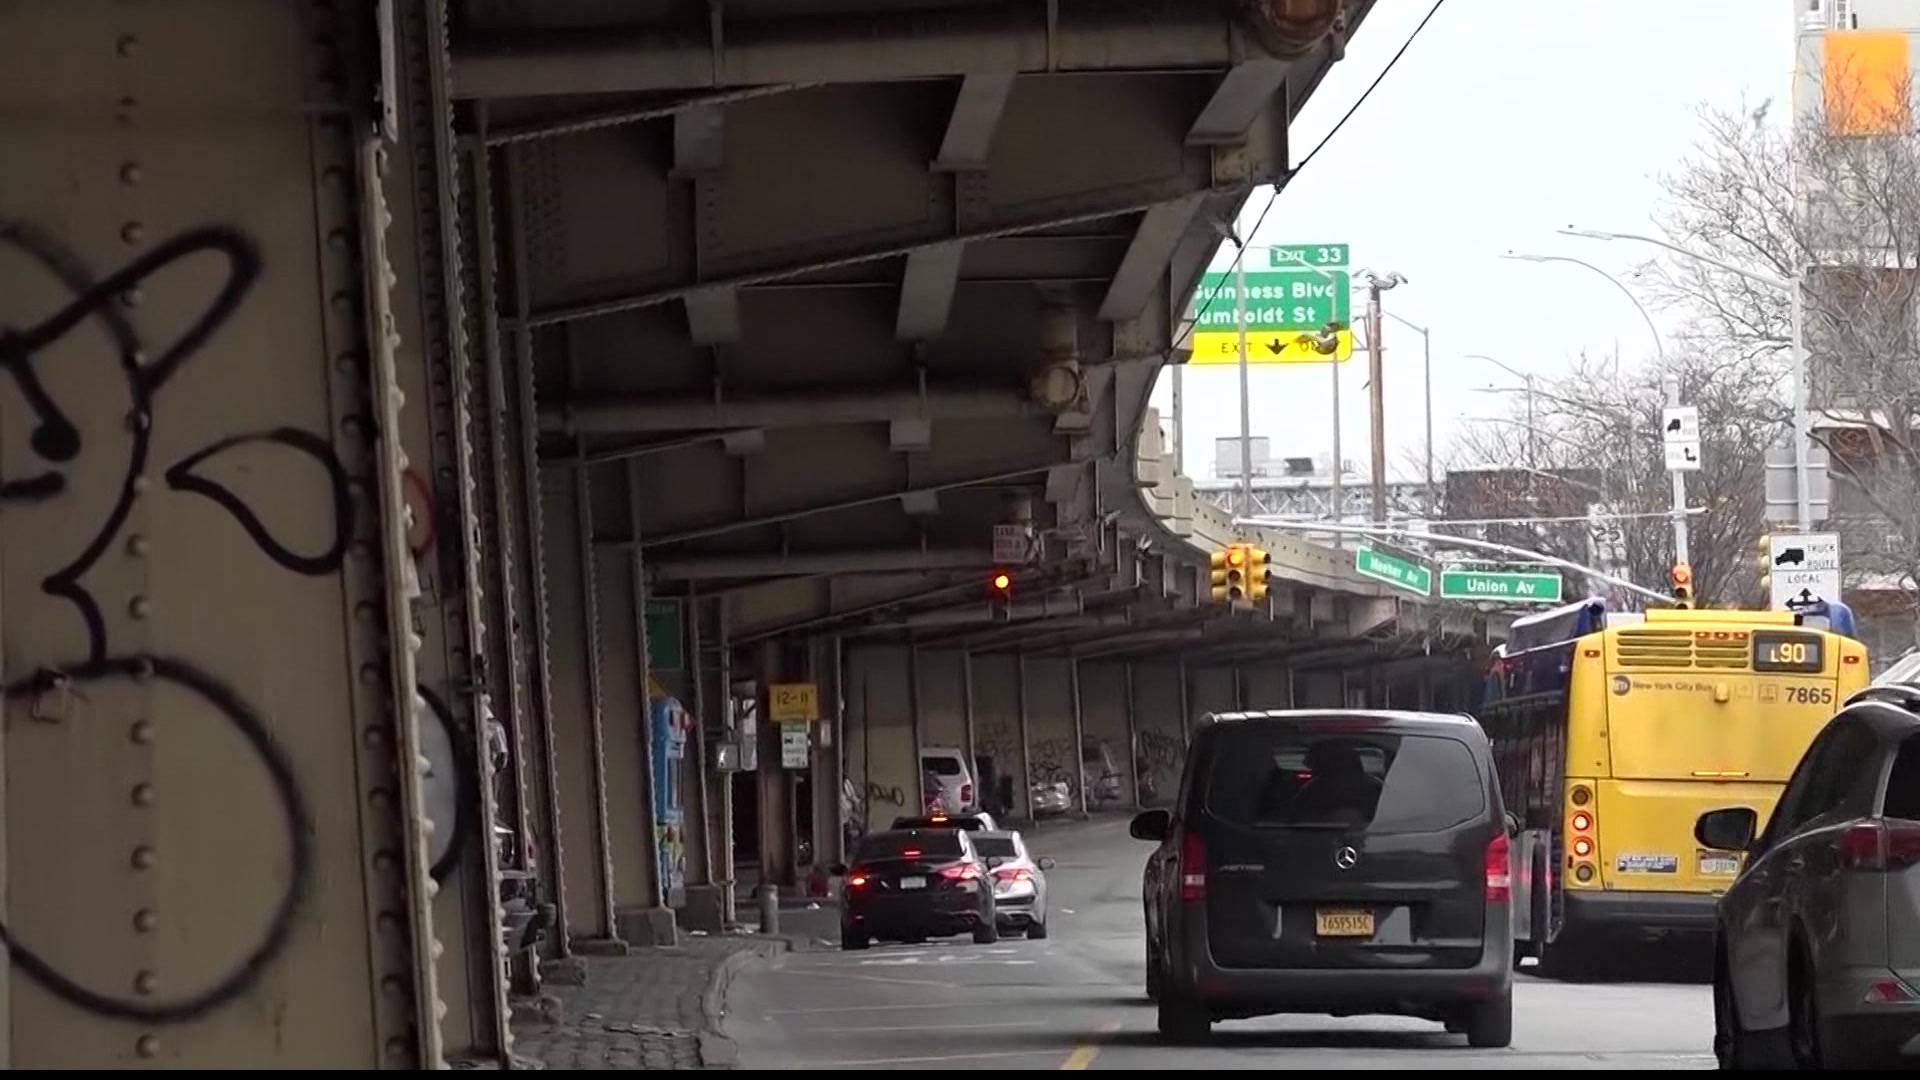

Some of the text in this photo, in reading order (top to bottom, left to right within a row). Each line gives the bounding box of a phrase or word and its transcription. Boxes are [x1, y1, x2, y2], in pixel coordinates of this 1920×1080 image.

[1317, 247, 1341, 262] 33
[1293, 306, 1316, 323] St
[1221, 342, 1254, 354] EXT
[1807, 544, 1836, 553] TRUCK
[1467, 578, 1536, 594] Union Av
[1787, 574, 1821, 584] LOCAL
[1770, 643, 1805, 664] L90
[1675, 681, 1693, 692] City
[1784, 686, 1833, 704] 7865
